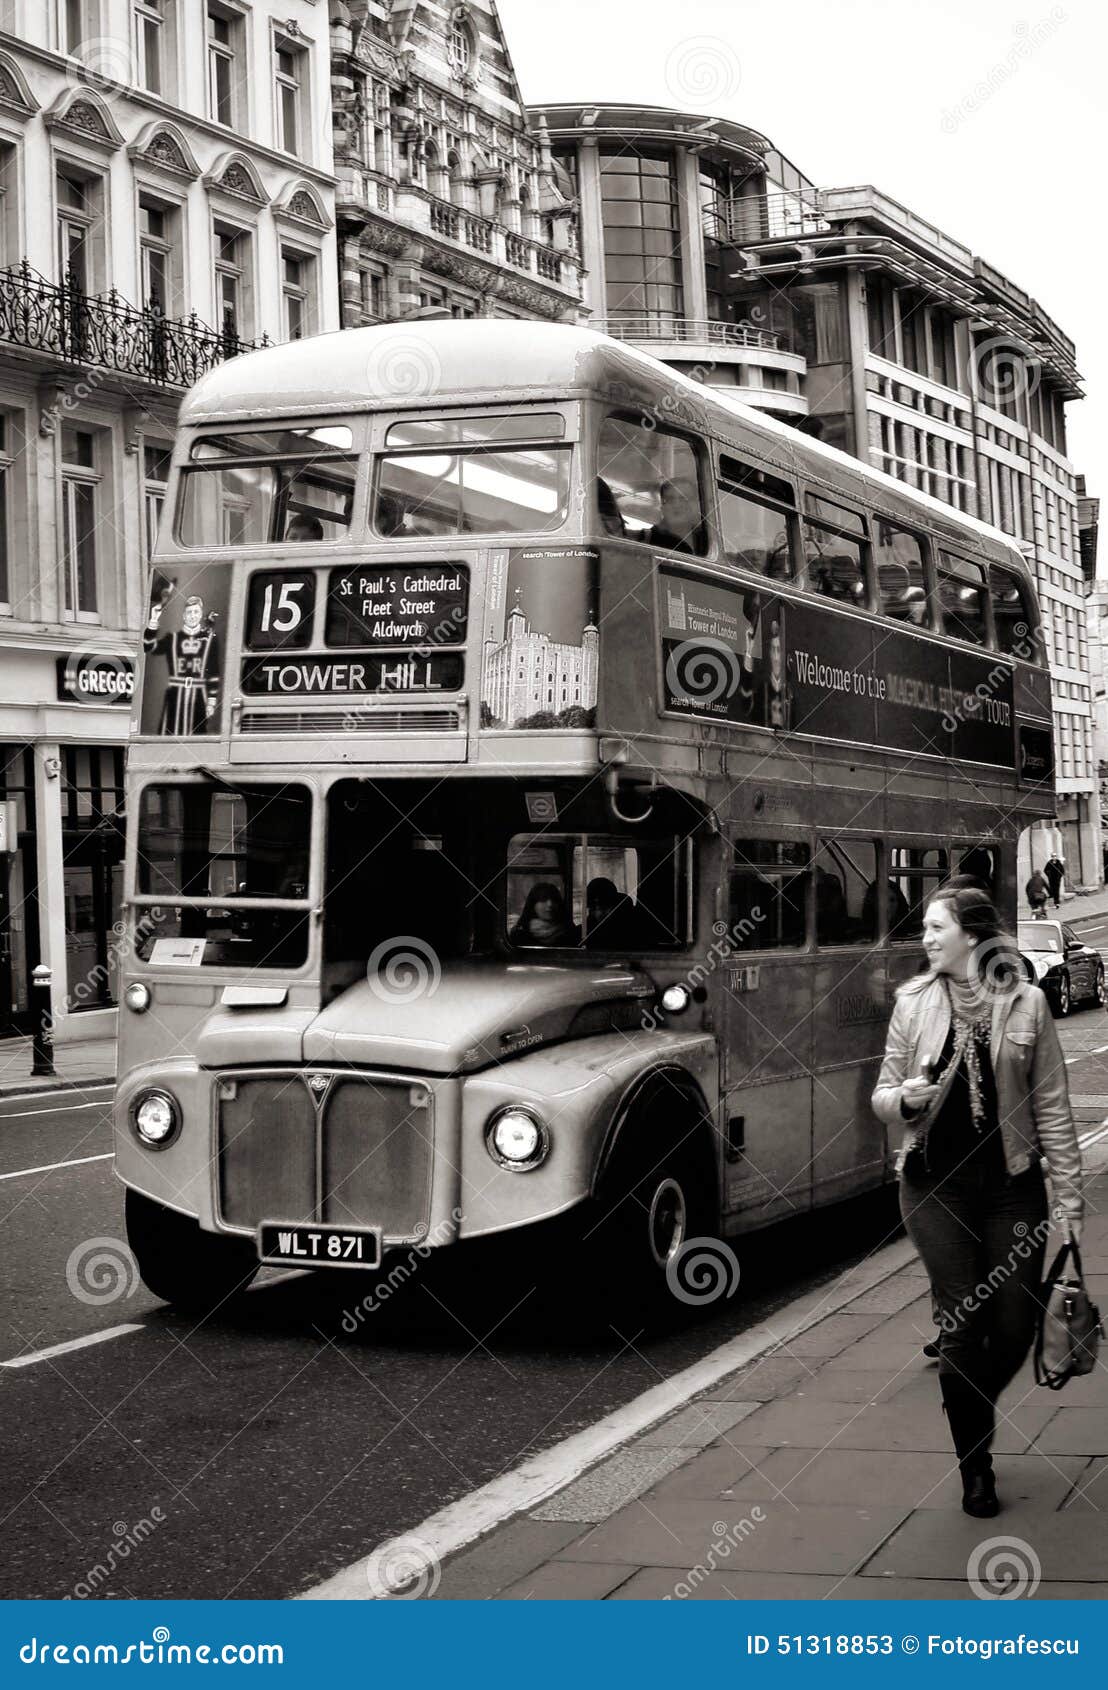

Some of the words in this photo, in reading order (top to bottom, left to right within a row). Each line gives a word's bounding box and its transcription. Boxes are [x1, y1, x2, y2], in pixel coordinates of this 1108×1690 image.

[340, 578, 352, 595] St
[360, 576, 396, 594] Paul's
[403, 574, 461, 592] Cathedral
[261, 583, 304, 632] 15
[362, 599, 392, 616] Fleet
[399, 598, 436, 615] Street
[372, 620, 423, 641] Aldwych
[688, 617, 708, 633] Tower
[709, 622, 717, 635] of
[79, 669, 134, 695] GREGGS
[262, 665, 367, 692] TOWER
[380, 662, 442, 689] HILL
[795, 650, 851, 692] Welcome
[852, 669, 866, 695] to
[867, 671, 886, 700] the
[985, 698, 1011, 727] TOUR
[527, 1033, 544, 1045] OPEN
[278, 1232, 322, 1256] WLT
[327, 1235, 363, 1259] 871
